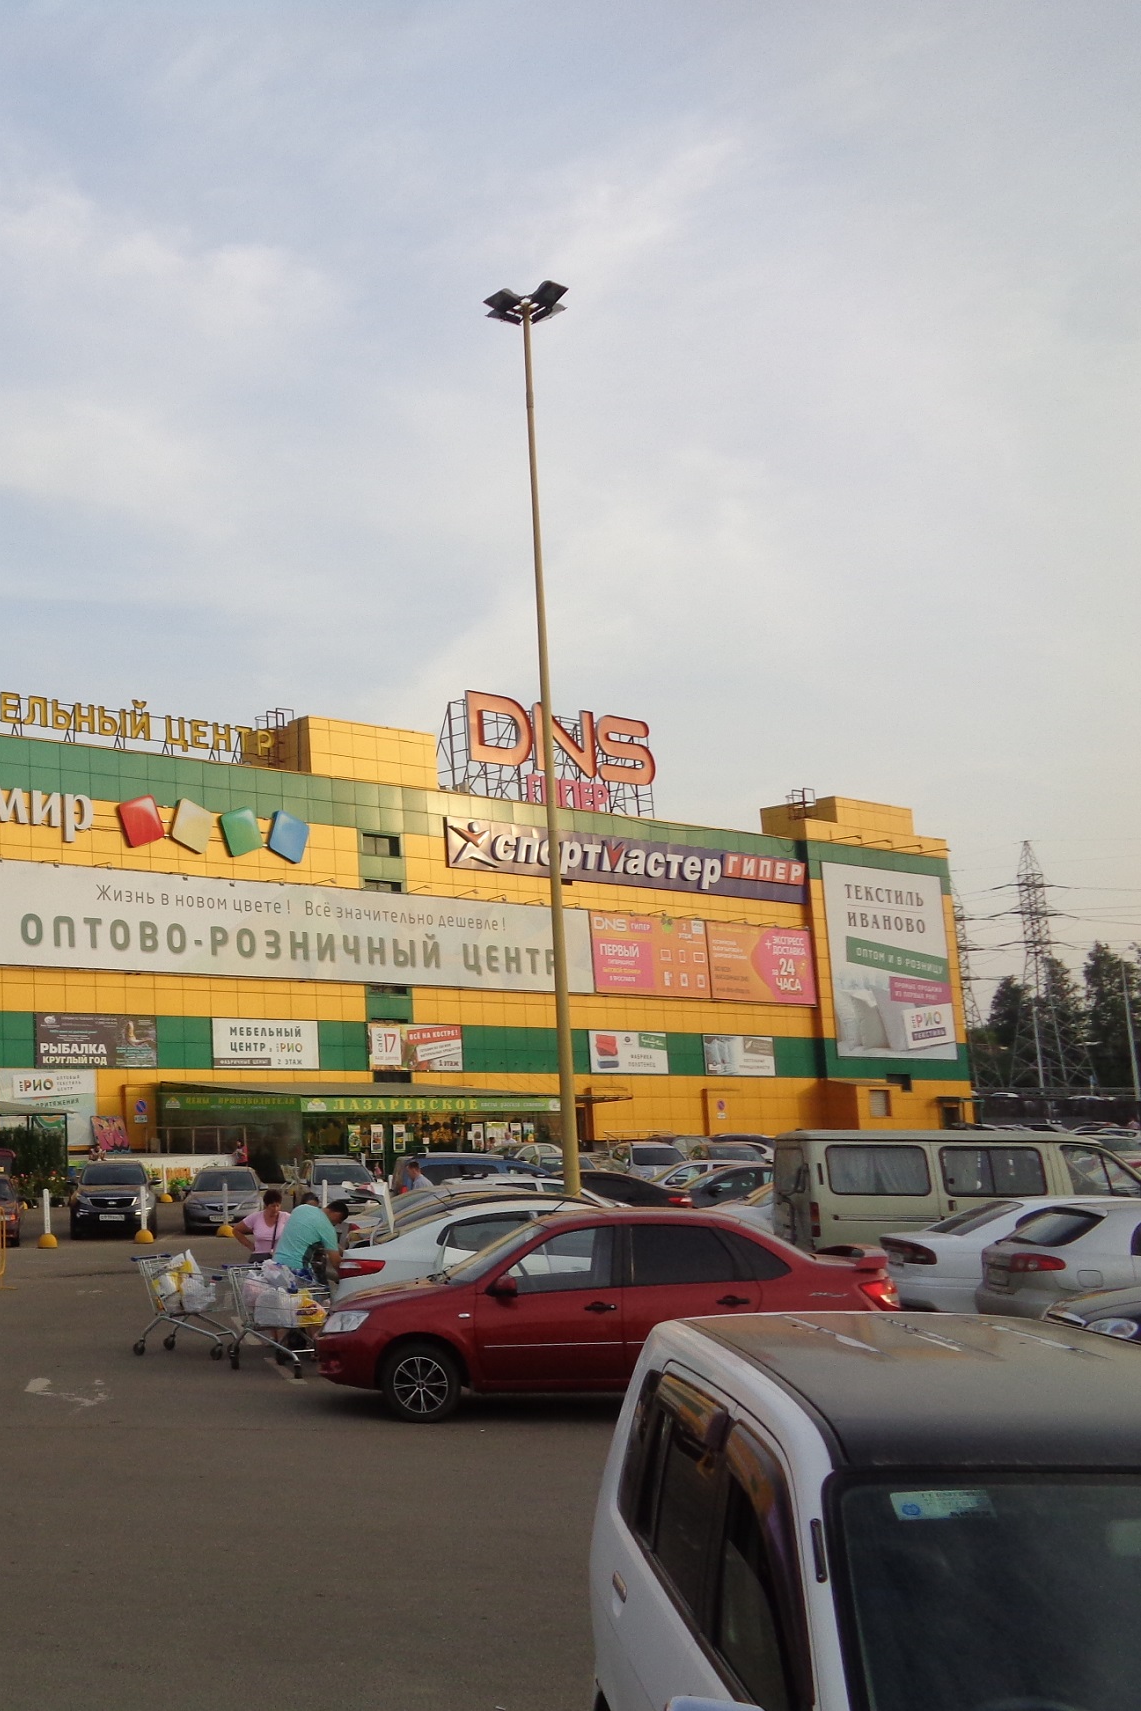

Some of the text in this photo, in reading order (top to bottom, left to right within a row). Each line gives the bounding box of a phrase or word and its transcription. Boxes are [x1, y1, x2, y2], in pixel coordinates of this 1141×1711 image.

[164, 714, 276, 756] ЦЕНТР
[465, 690, 656, 786] DNS
[725, 853, 804, 885] ГИПЕР
[844, 883, 924, 907] ТЕКСТИЛЬ
[96, 883, 155, 906] Жизнь
[161, 893, 169, 906] в
[175, 895, 227, 910] новом
[304, 900, 332, 917] Всё
[336, 906, 434, 927] значительно
[593, 916, 627, 932] DNS
[630, 922, 651, 931] ГИПЕР
[846, 911, 926, 934] ИВАНОВО
[20, 912, 556, 976] ОПТОВО-РОЗНИЧНЫЙ ЦЕНТР
[772, 936, 804, 946] ЭКСПРЕСС
[599, 943, 640, 958] ПЕРВЫЙ
[772, 945, 806, 956] ДОСТАВКА
[779, 957, 795, 976] 24
[855, 947, 943, 974] ОПТОМ И В РОЗНИЦУ
[775, 977, 803, 991] ЧАСА
[916, 1011, 942, 1028] РИО
[229, 1025, 302, 1038] МЕБЕЛЬНЫЙ
[409, 1032, 421, 1041] ВСЁ
[432, 1029, 458, 1038] КОСТРЕ!
[39, 1043, 107, 1055] РЫБАЛКА
[230, 1042, 266, 1053] ЦЕНТР
[280, 1042, 303, 1053] РИО
[384, 1033, 397, 1053] 17
[42, 1055, 88, 1064] КРУГЛЫЙ
[88, 1056, 108, 1066] ГОД
[284, 1058, 303, 1066] ЭТАЖ
[23, 1078, 54, 1092] РИО
[185, 1097, 210, 1105] ЦЕНЫ
[333, 1097, 478, 1111] ЛАЗАРЕВСКОЕ
